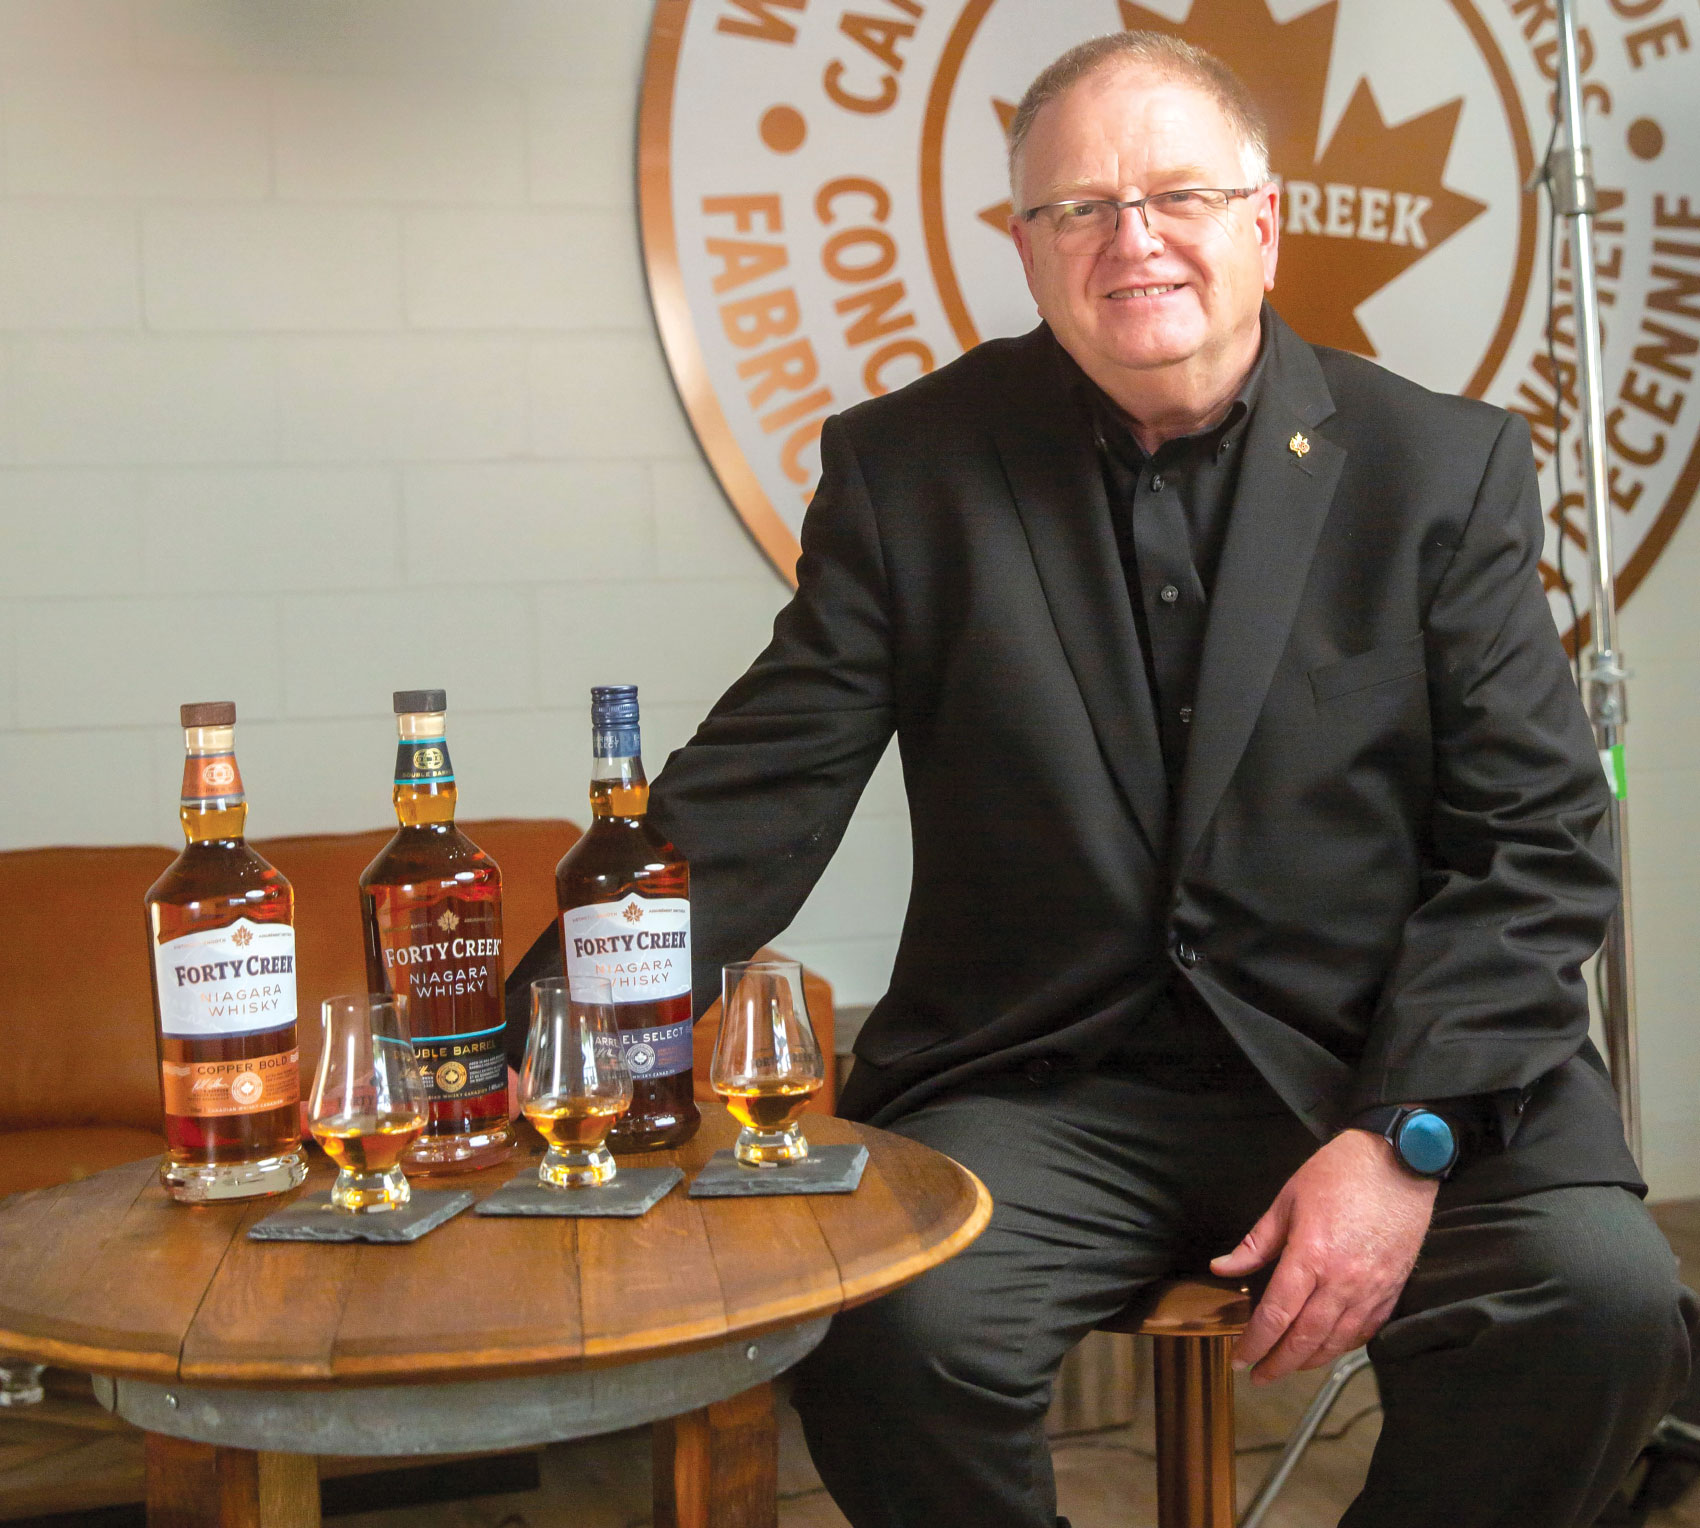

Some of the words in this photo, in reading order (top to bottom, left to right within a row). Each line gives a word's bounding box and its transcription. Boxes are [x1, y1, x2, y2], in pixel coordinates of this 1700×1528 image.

[1270, 172, 1433, 250] REEK
[702, 194, 835, 500] FABRIC
[384, 942, 449, 968] FORTY
[452, 938, 500, 959] CREEK
[574, 934, 634, 958] FORTY
[636, 931, 686, 951] CREEK
[175, 960, 243, 987] FORTY
[246, 955, 293, 976] CREEK
[409, 966, 488, 985] NIAGARA
[595, 958, 672, 974] NIAGARA
[201, 984, 282, 1003] NIAGARA
[416, 980, 484, 998] WHISKY
[209, 998, 278, 1017] WHISKY
[643, 1026, 683, 1043] SELECT
[453, 1039, 497, 1056] BARREL
[197, 1062, 253, 1075] COPPER
[259, 1055, 287, 1070] BOLD
